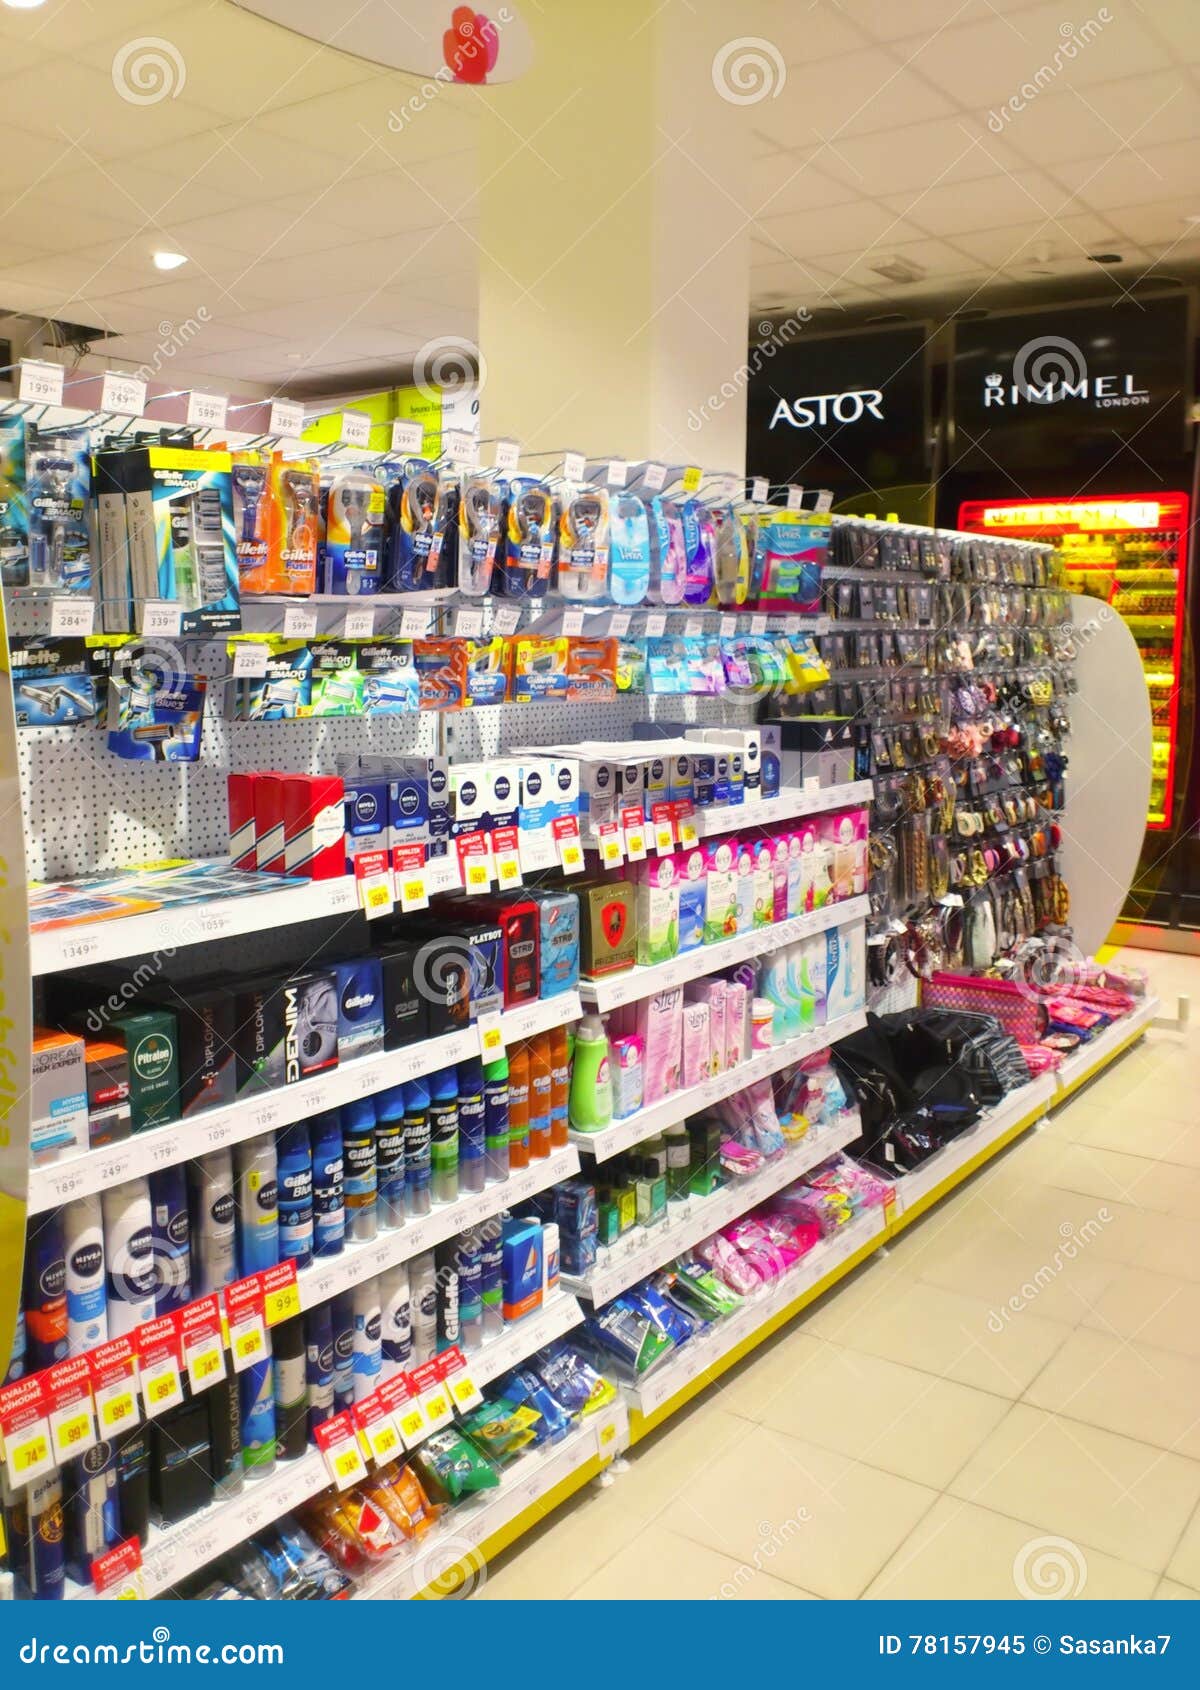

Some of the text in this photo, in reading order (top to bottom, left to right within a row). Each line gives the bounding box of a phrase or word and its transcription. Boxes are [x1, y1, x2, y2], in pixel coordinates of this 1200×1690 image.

[29, 382, 49, 394] 199
[984, 373, 1149, 407] RIMMEL
[1095, 396, 1150, 408] LONDON
[198, 408, 214, 418] 599
[769, 390, 884, 430] ASTOR
[60, 616, 80, 626] 284
[151, 617, 168, 626] 339
[10, 651, 60, 667] illette
[358, 802, 375, 810] NIVEA
[469, 930, 502, 944] PLAYBOY
[552, 936, 573, 946] STR8
[512, 944, 532, 954] STR8
[286, 988, 298, 1083] DENIM
[76, 1252, 101, 1264] NIVEA
[264, 1265, 291, 1280] KVALITA
[230, 1278, 258, 1294] KVALITA
[183, 1300, 213, 1318] KVALITA
[276, 1297, 291, 1311] 99
[446, 1274, 458, 1340] Gillette
[141, 1318, 172, 1335] KVALITA
[95, 1340, 129, 1358] KVALITA
[244, 1342, 254, 1354] 99
[51, 1359, 87, 1378] KVALITA
[1, 1380, 38, 1401] KVALITA
[157, 1384, 168, 1398] 99
[112, 1404, 124, 1418] 99
[68, 1427, 80, 1440] 99
[24, 1450, 38, 1466] 74
